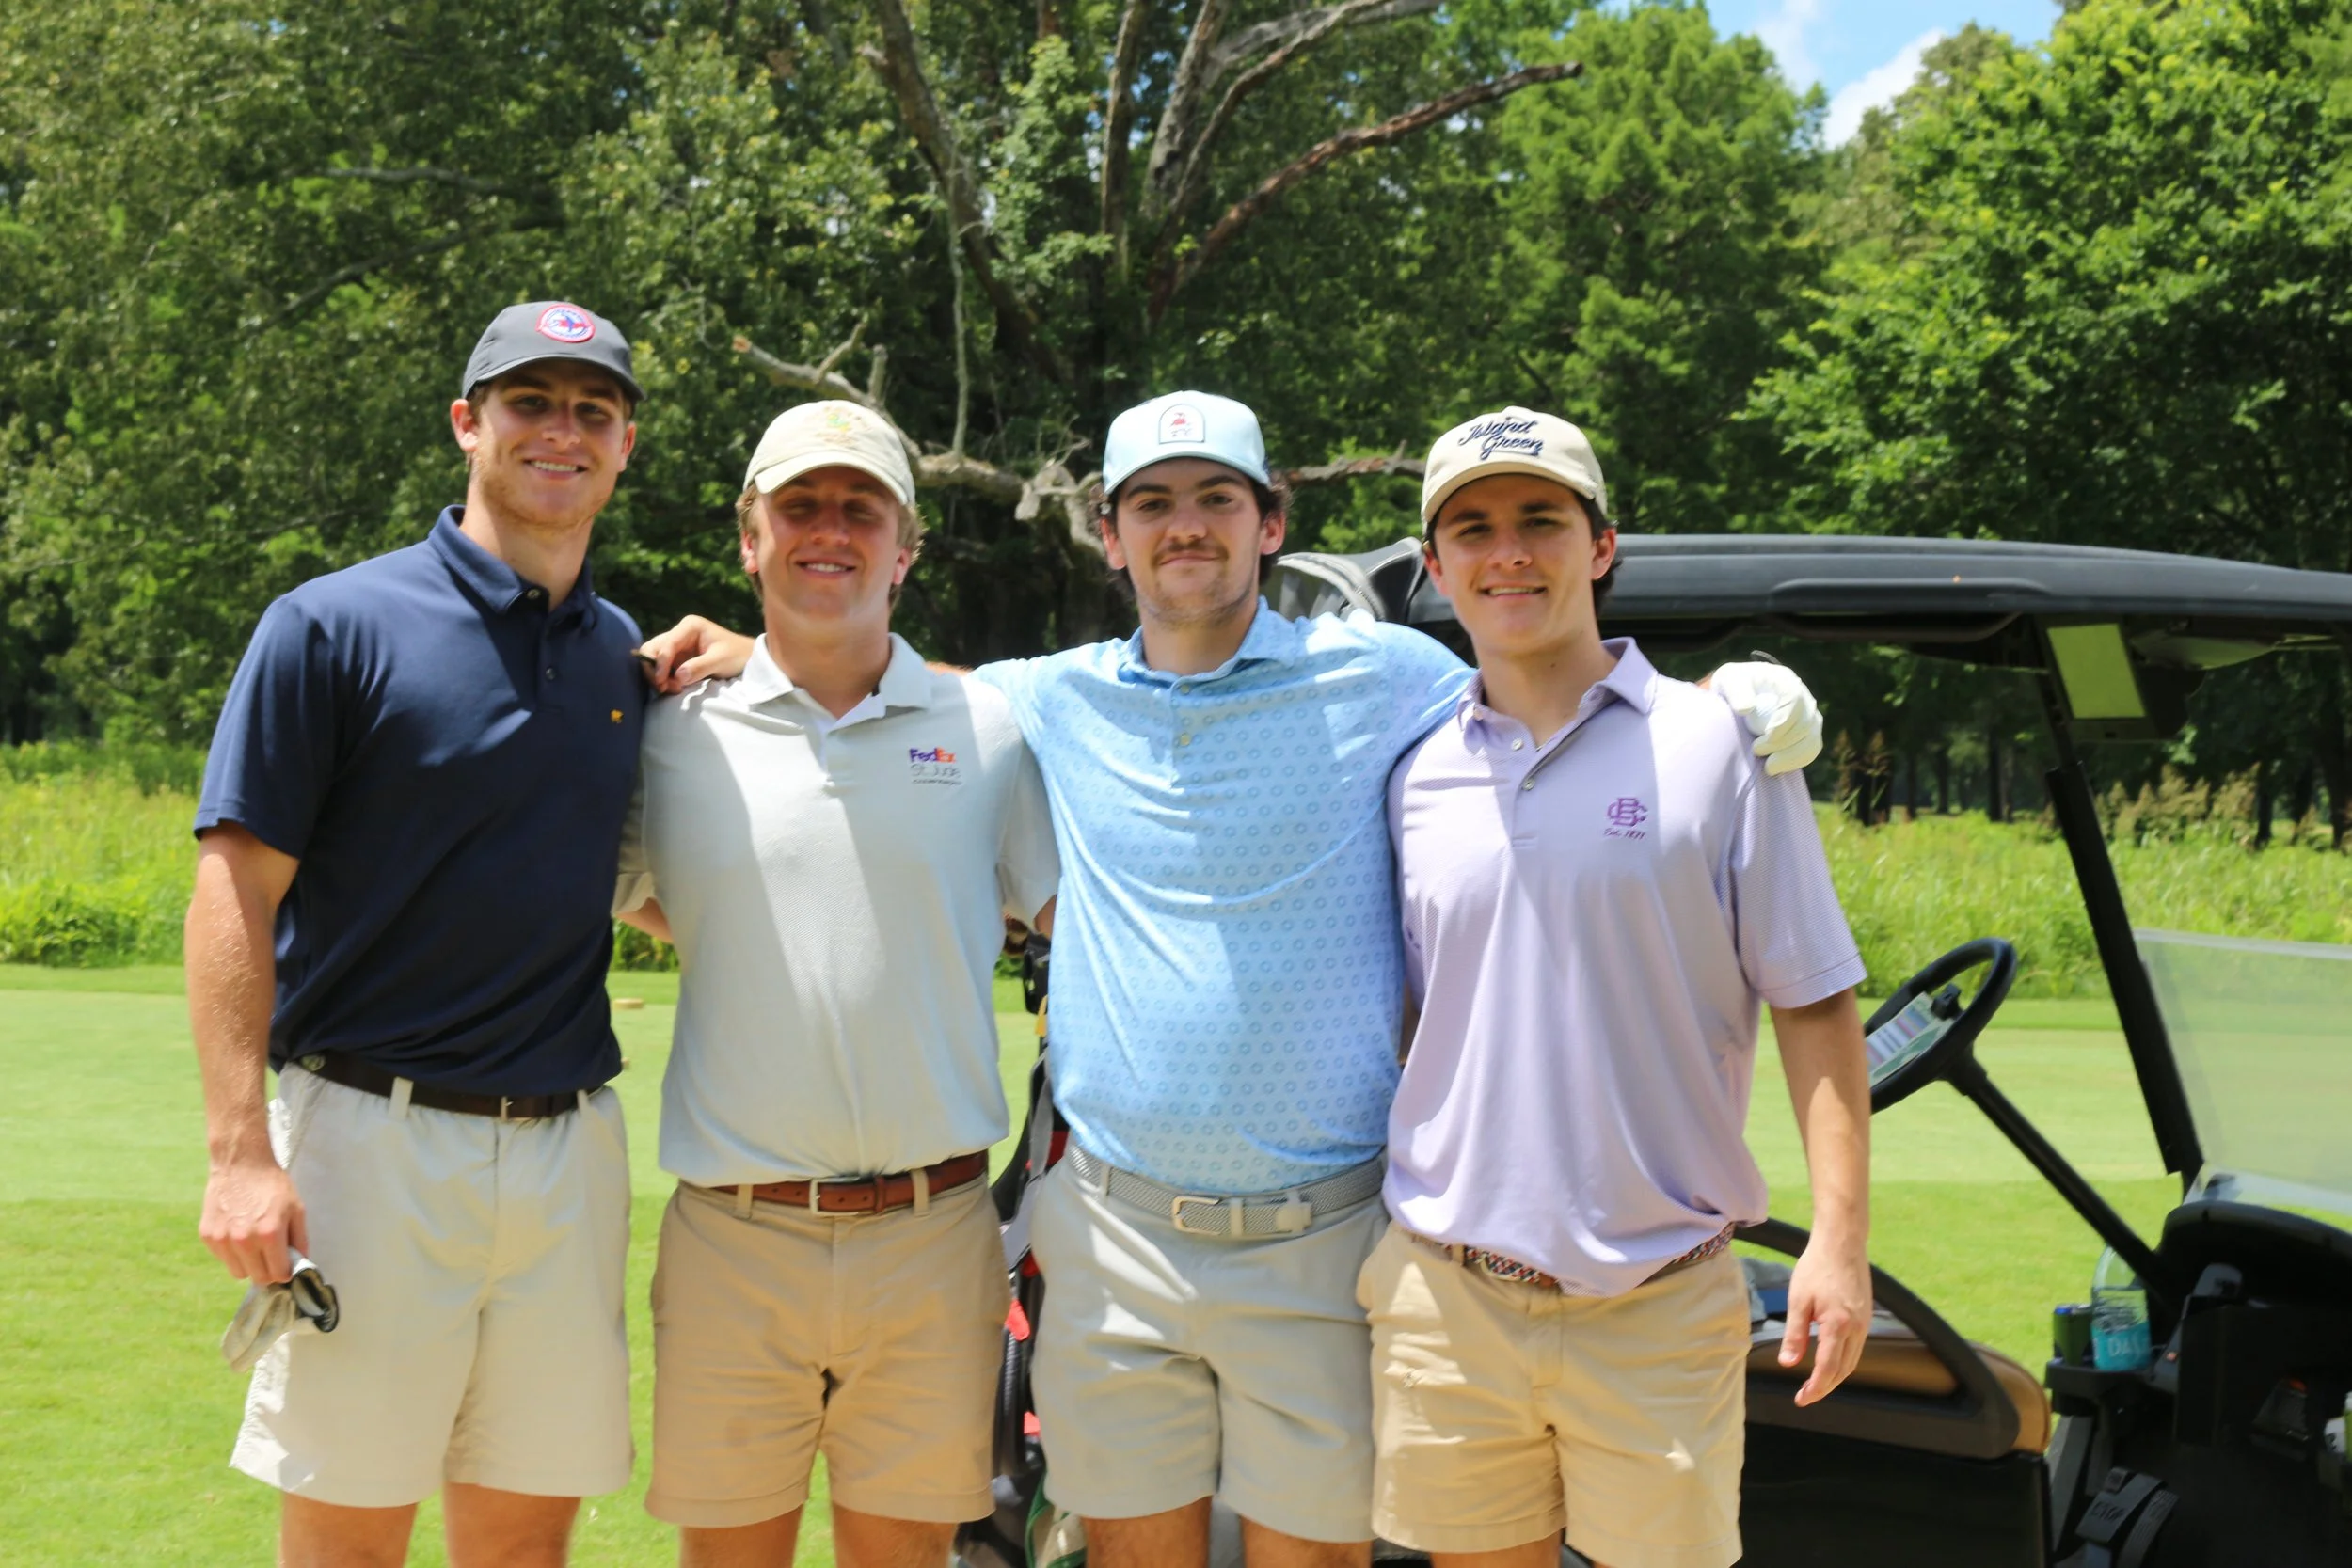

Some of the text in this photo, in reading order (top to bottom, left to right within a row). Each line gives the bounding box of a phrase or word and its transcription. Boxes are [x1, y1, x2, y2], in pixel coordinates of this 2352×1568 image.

[1458, 417, 1538, 446] Island
[1479, 435, 1544, 460] Green
[909, 747, 957, 763] FedEx
